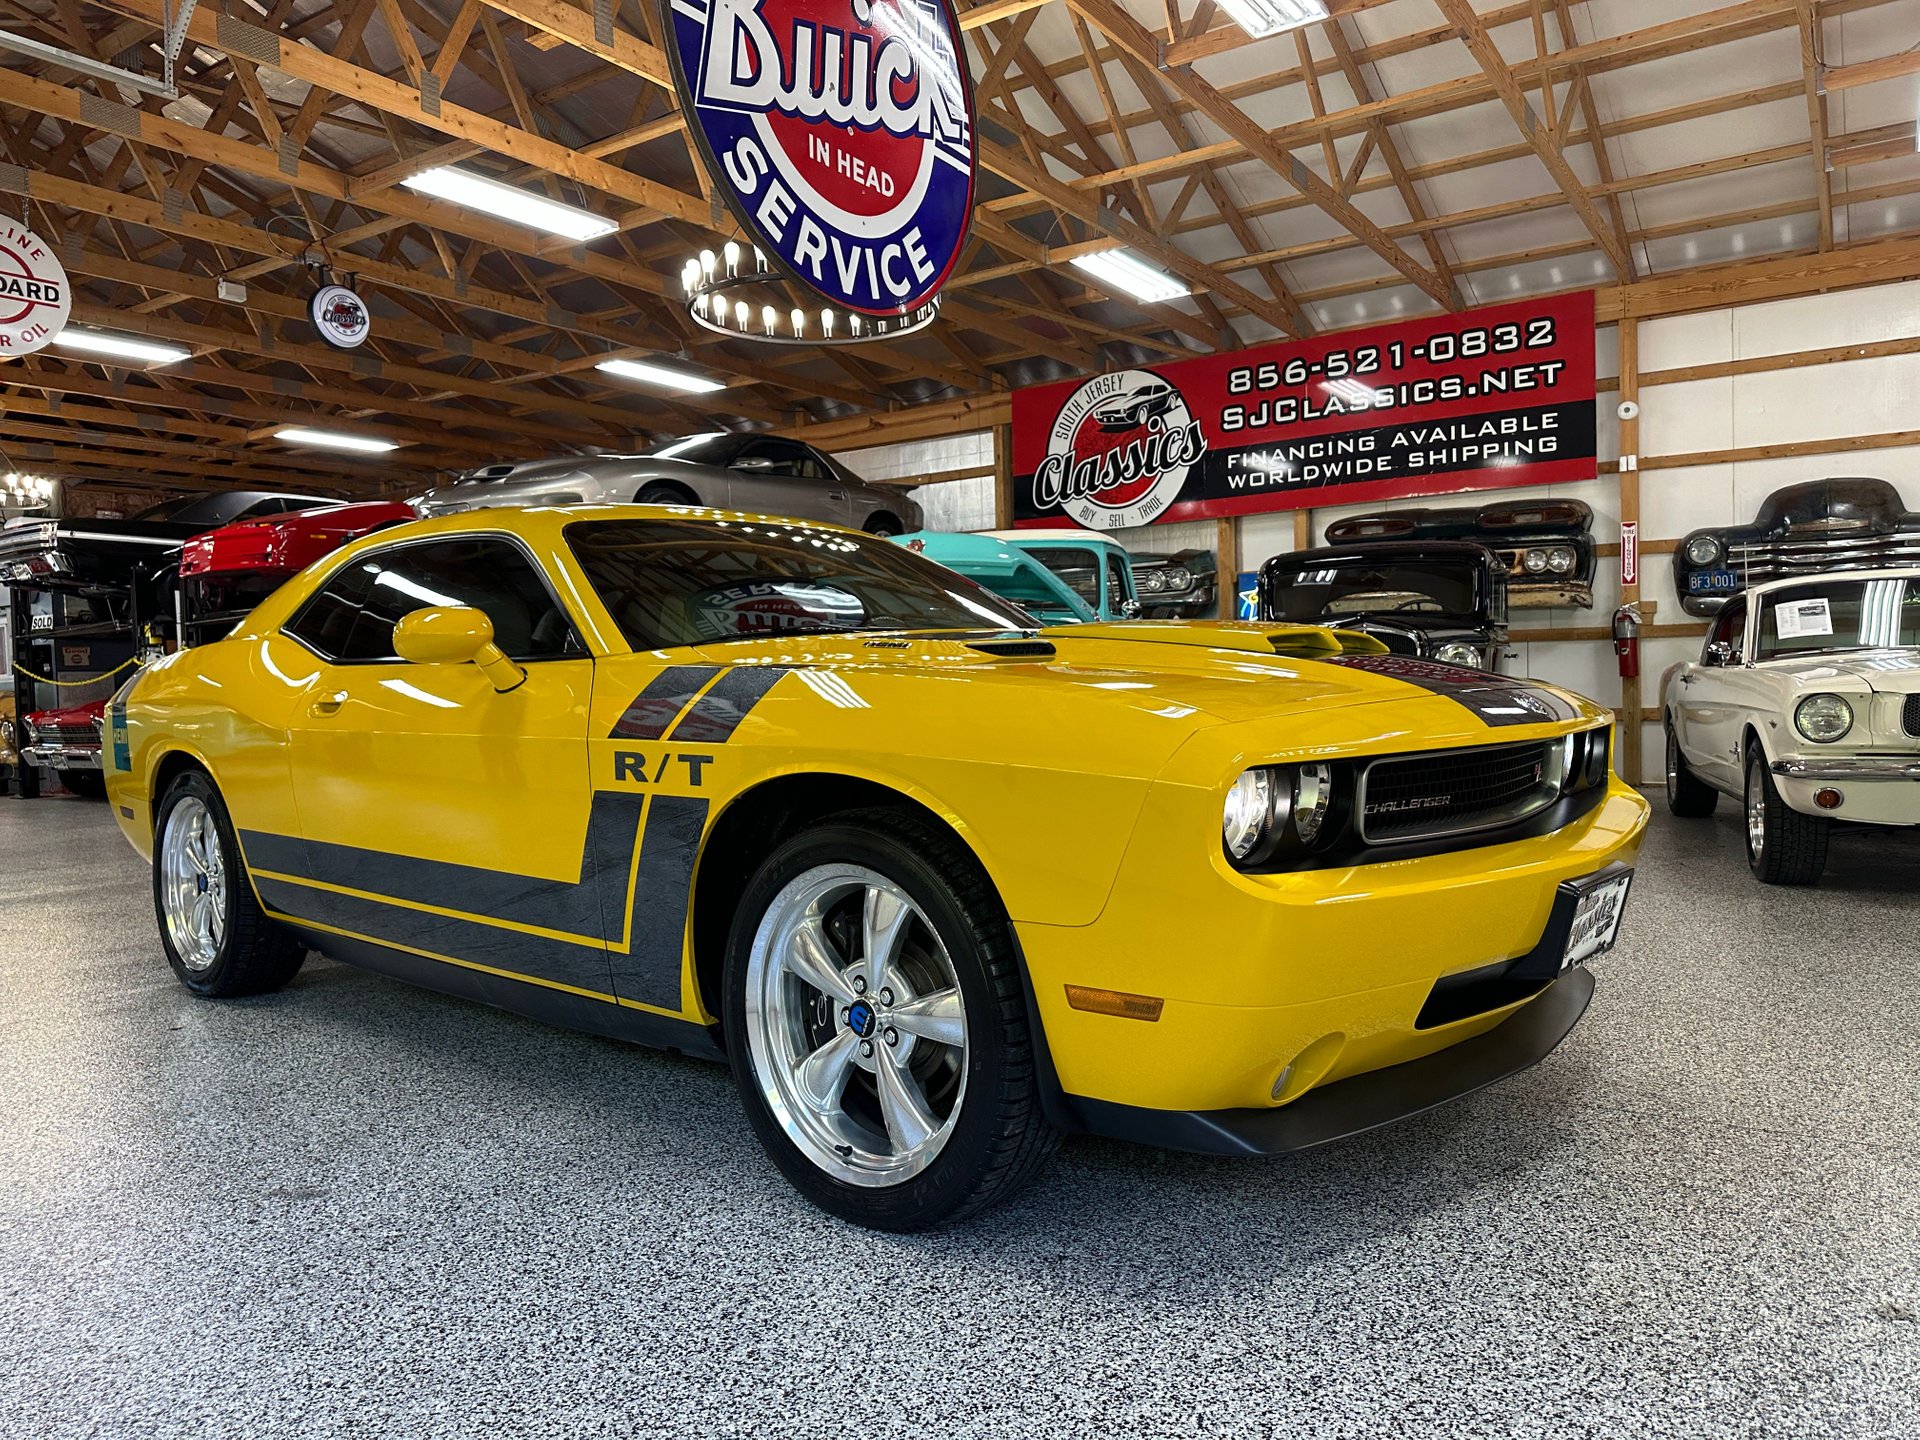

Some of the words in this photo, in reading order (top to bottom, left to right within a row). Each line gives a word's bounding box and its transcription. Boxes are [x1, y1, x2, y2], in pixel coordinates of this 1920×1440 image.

[703, 0, 963, 138] Buick
[808, 133, 830, 167] IN
[837, 148, 895, 197] HEAD
[723, 136, 935, 300] SERVICE
[21, 323, 49, 343] OIL
[1230, 320, 1553, 393] 856-521-0832
[1055, 401, 1084, 440] SOUTH
[1084, 373, 1124, 403] JERSEY
[1033, 416, 1207, 509] Classics
[1227, 436, 1375, 469] FINANCING
[1391, 412, 1558, 448] AVAILABLE
[1227, 456, 1392, 489] WORLDWIDE
[1408, 436, 1557, 468] SHIPPING
[1079, 505, 1097, 523] BUY
[1108, 514, 1125, 527] SELL
[1138, 494, 1163, 520] TRADE
[1690, 576, 1710, 589] BF3
[1714, 574, 1735, 587] 001
[32, 616, 52, 629] SOLD
[614, 750, 714, 787] R/T
[1364, 795, 1451, 815] CHALLENGER
